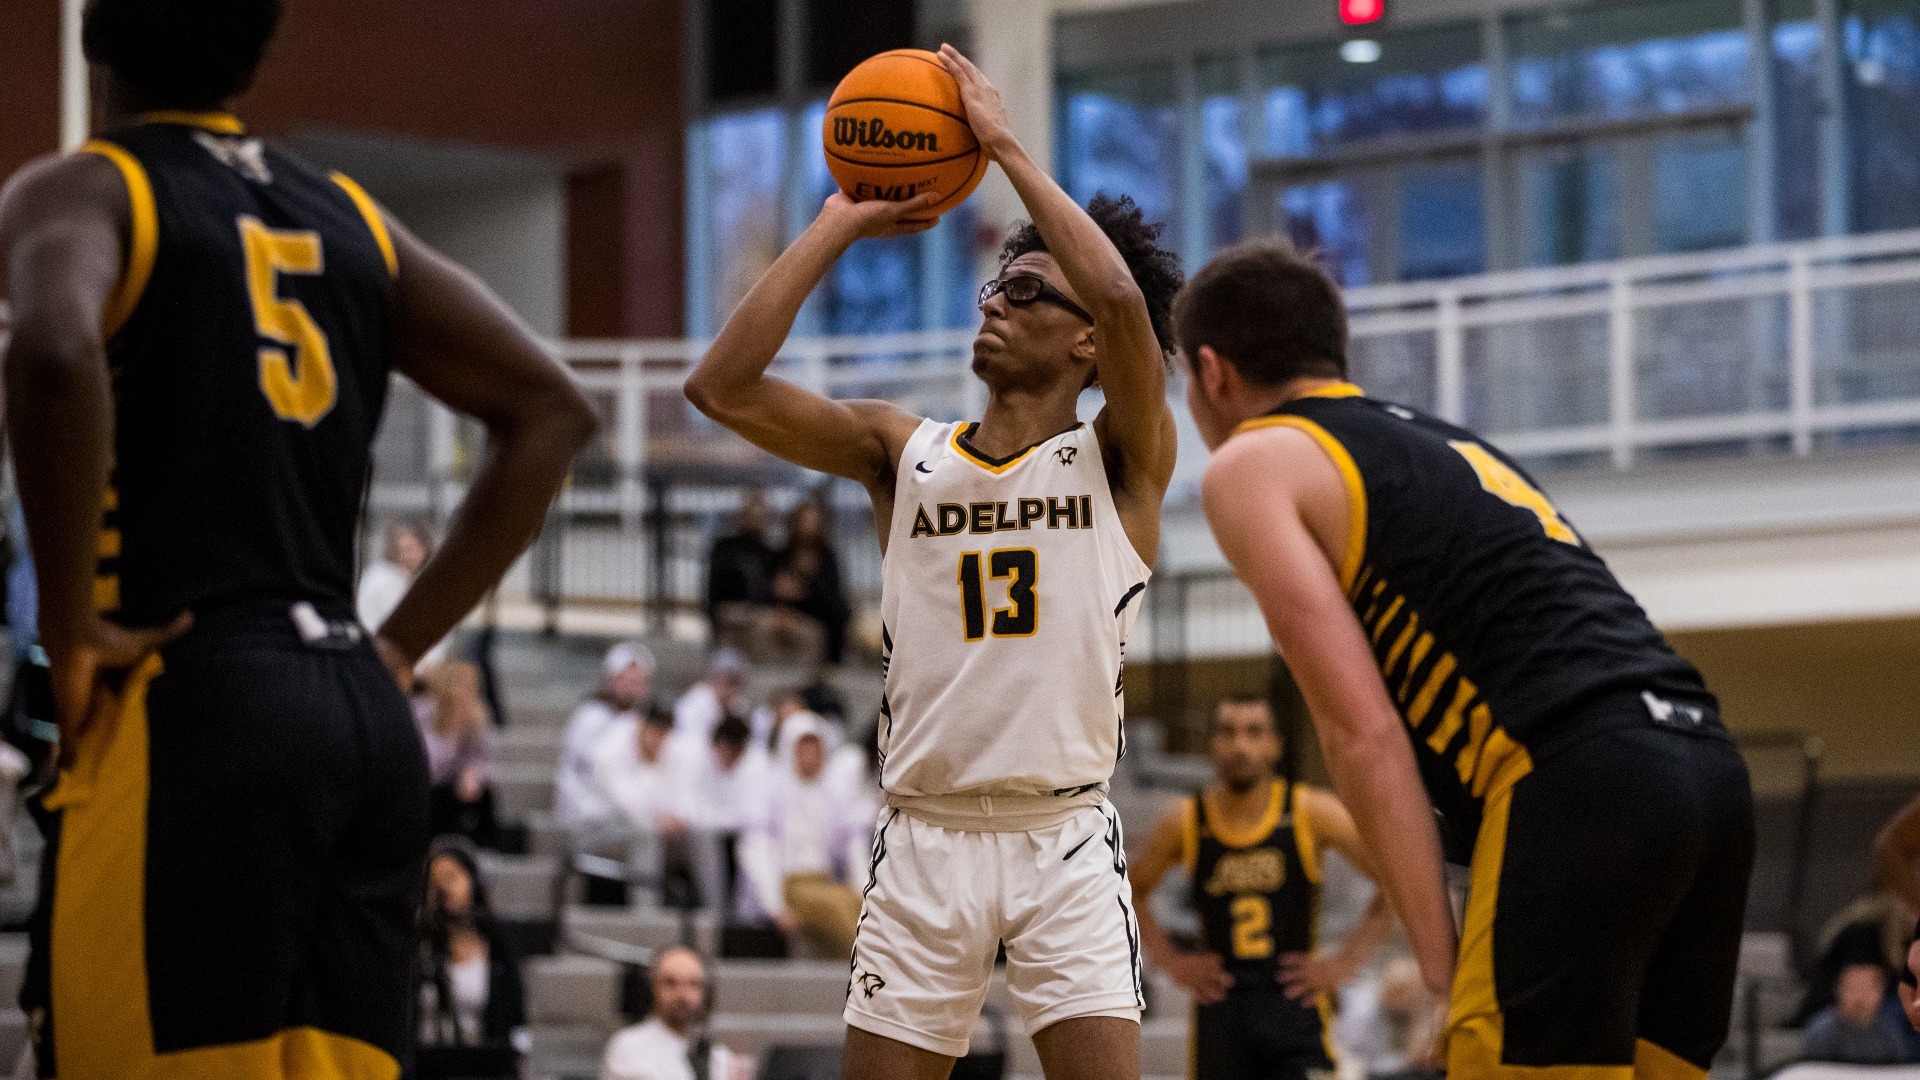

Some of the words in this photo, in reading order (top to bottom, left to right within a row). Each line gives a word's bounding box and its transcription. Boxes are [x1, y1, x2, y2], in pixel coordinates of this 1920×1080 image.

[834, 116, 938, 152] Wilson
[237, 213, 339, 428] 5
[910, 494, 1093, 538] ADELPHI
[957, 546, 1039, 643] 13
[1230, 896, 1275, 958] 2
